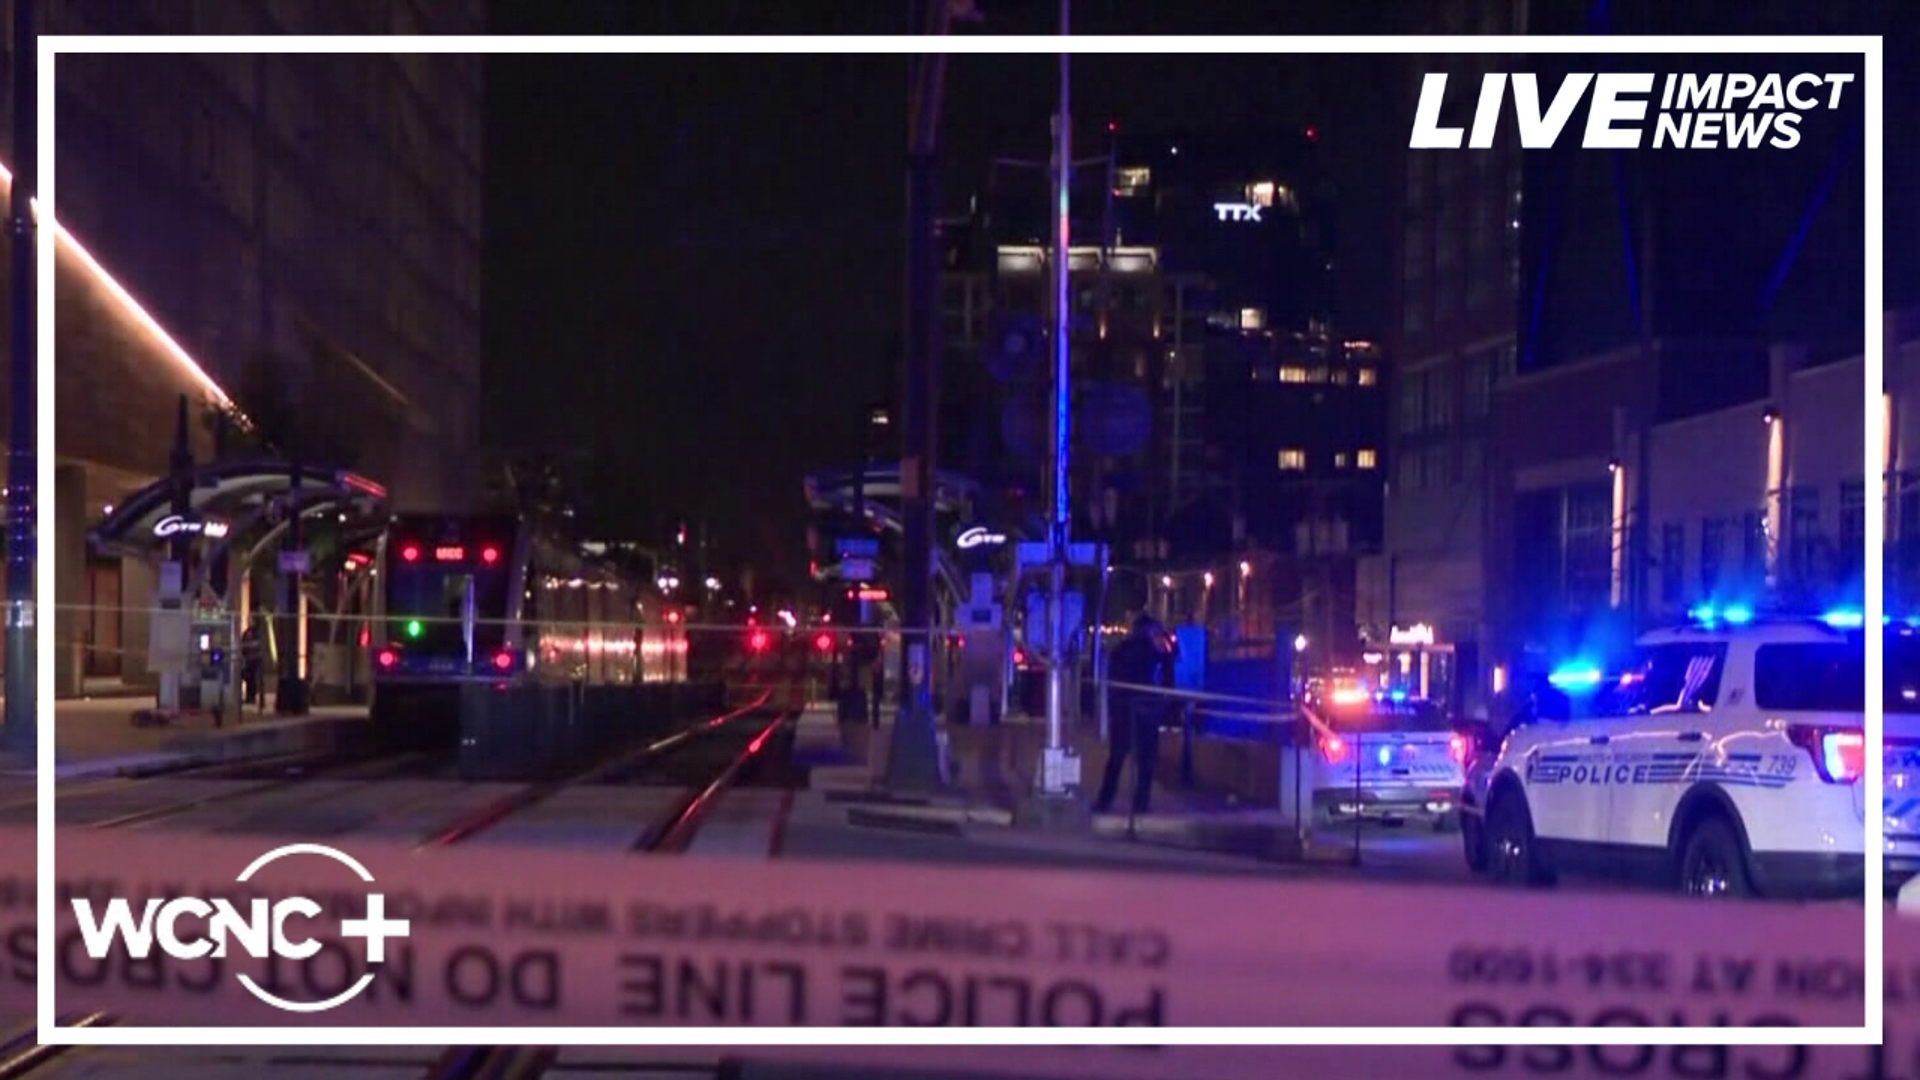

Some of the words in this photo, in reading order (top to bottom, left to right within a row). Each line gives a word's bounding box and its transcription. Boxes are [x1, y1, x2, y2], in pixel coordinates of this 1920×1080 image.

[1214, 203, 1262, 222] TTX
[1558, 764, 1648, 784] POLICE
[1767, 755, 1797, 775] 739
[626, 902, 870, 949] STOPPERS
[886, 913, 1031, 960] CRIME
[1050, 924, 1172, 970] CALL
[442, 945, 561, 1012] DO
[617, 955, 807, 1026] LINE
[840, 966, 1168, 1050] POLICE
[1448, 1002, 1810, 1080] CROSS
